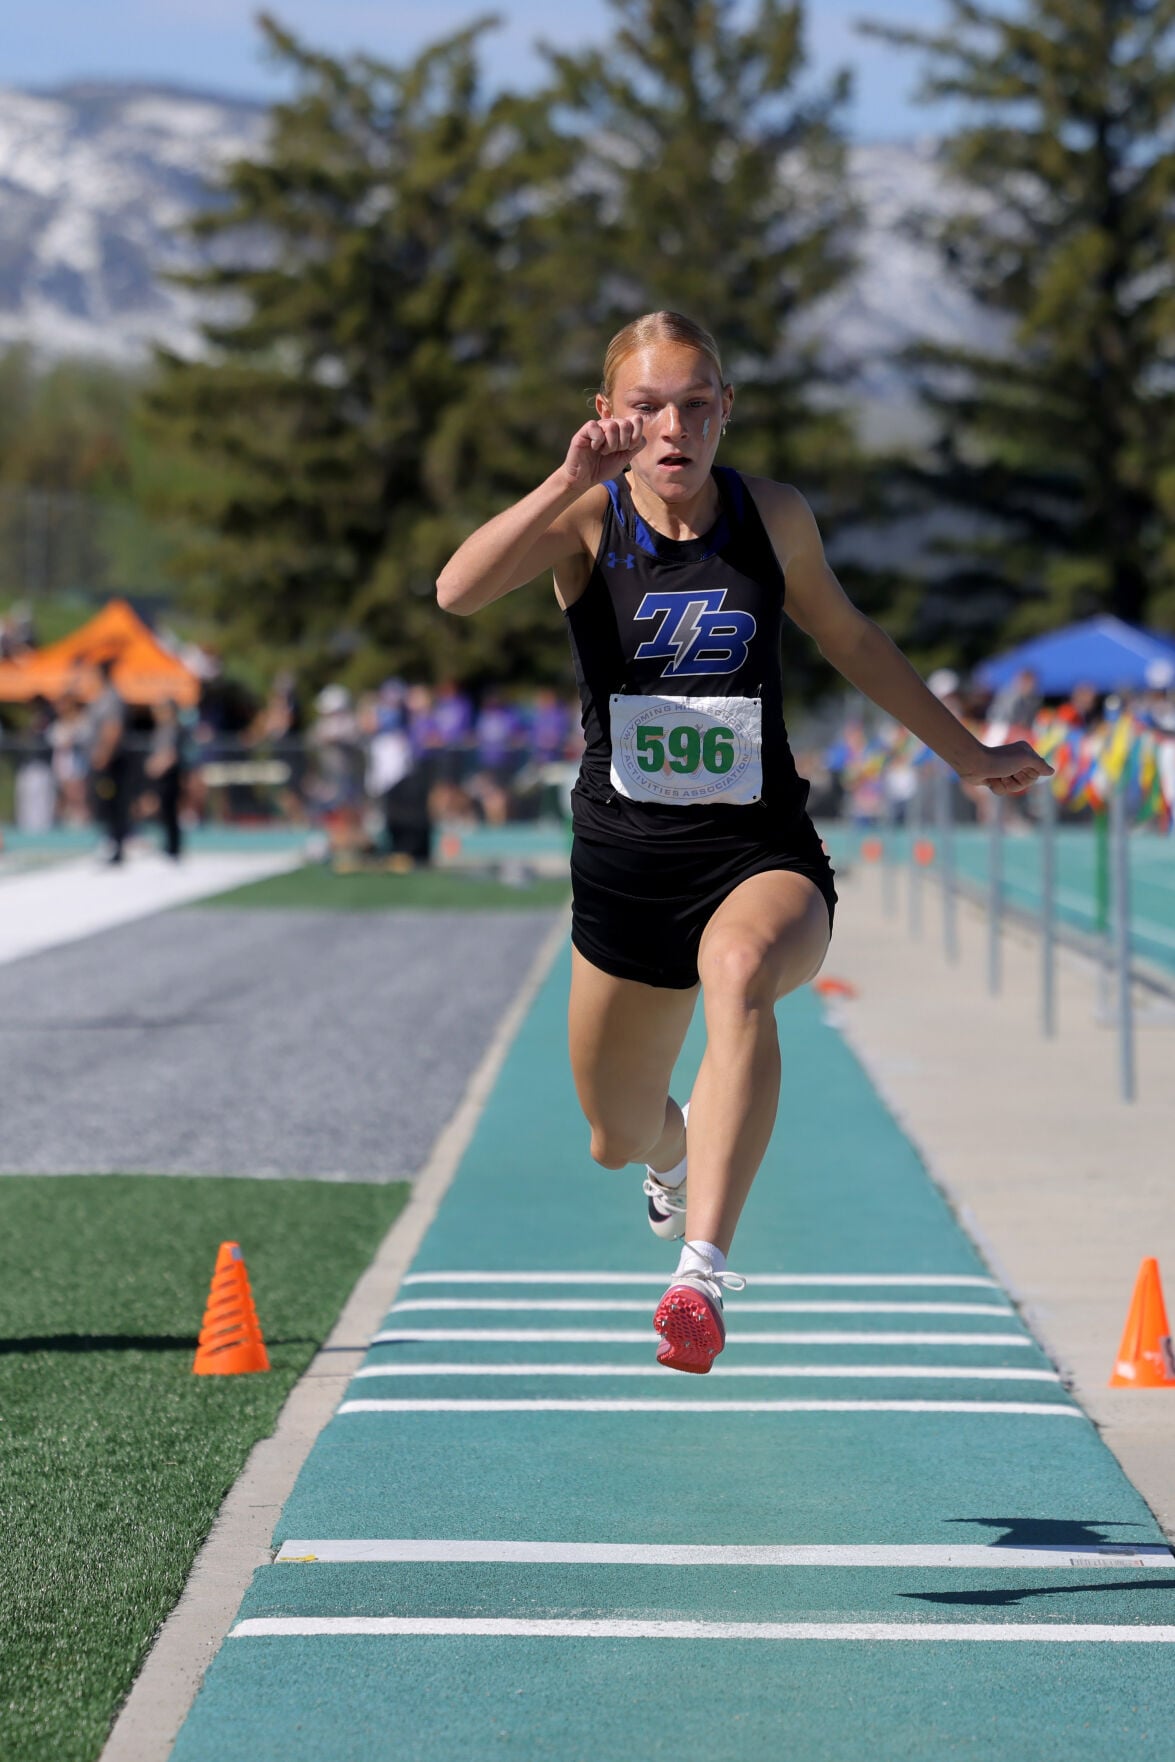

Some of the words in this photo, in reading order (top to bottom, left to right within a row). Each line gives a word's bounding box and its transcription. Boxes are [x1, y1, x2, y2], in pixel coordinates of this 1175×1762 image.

[633, 588, 757, 678] TB
[624, 705, 671, 740] WYOMING
[637, 726, 735, 774] 596
[624, 755, 679, 797] ACTIVITIES
[683, 753, 748, 797] ASSOCIATION
